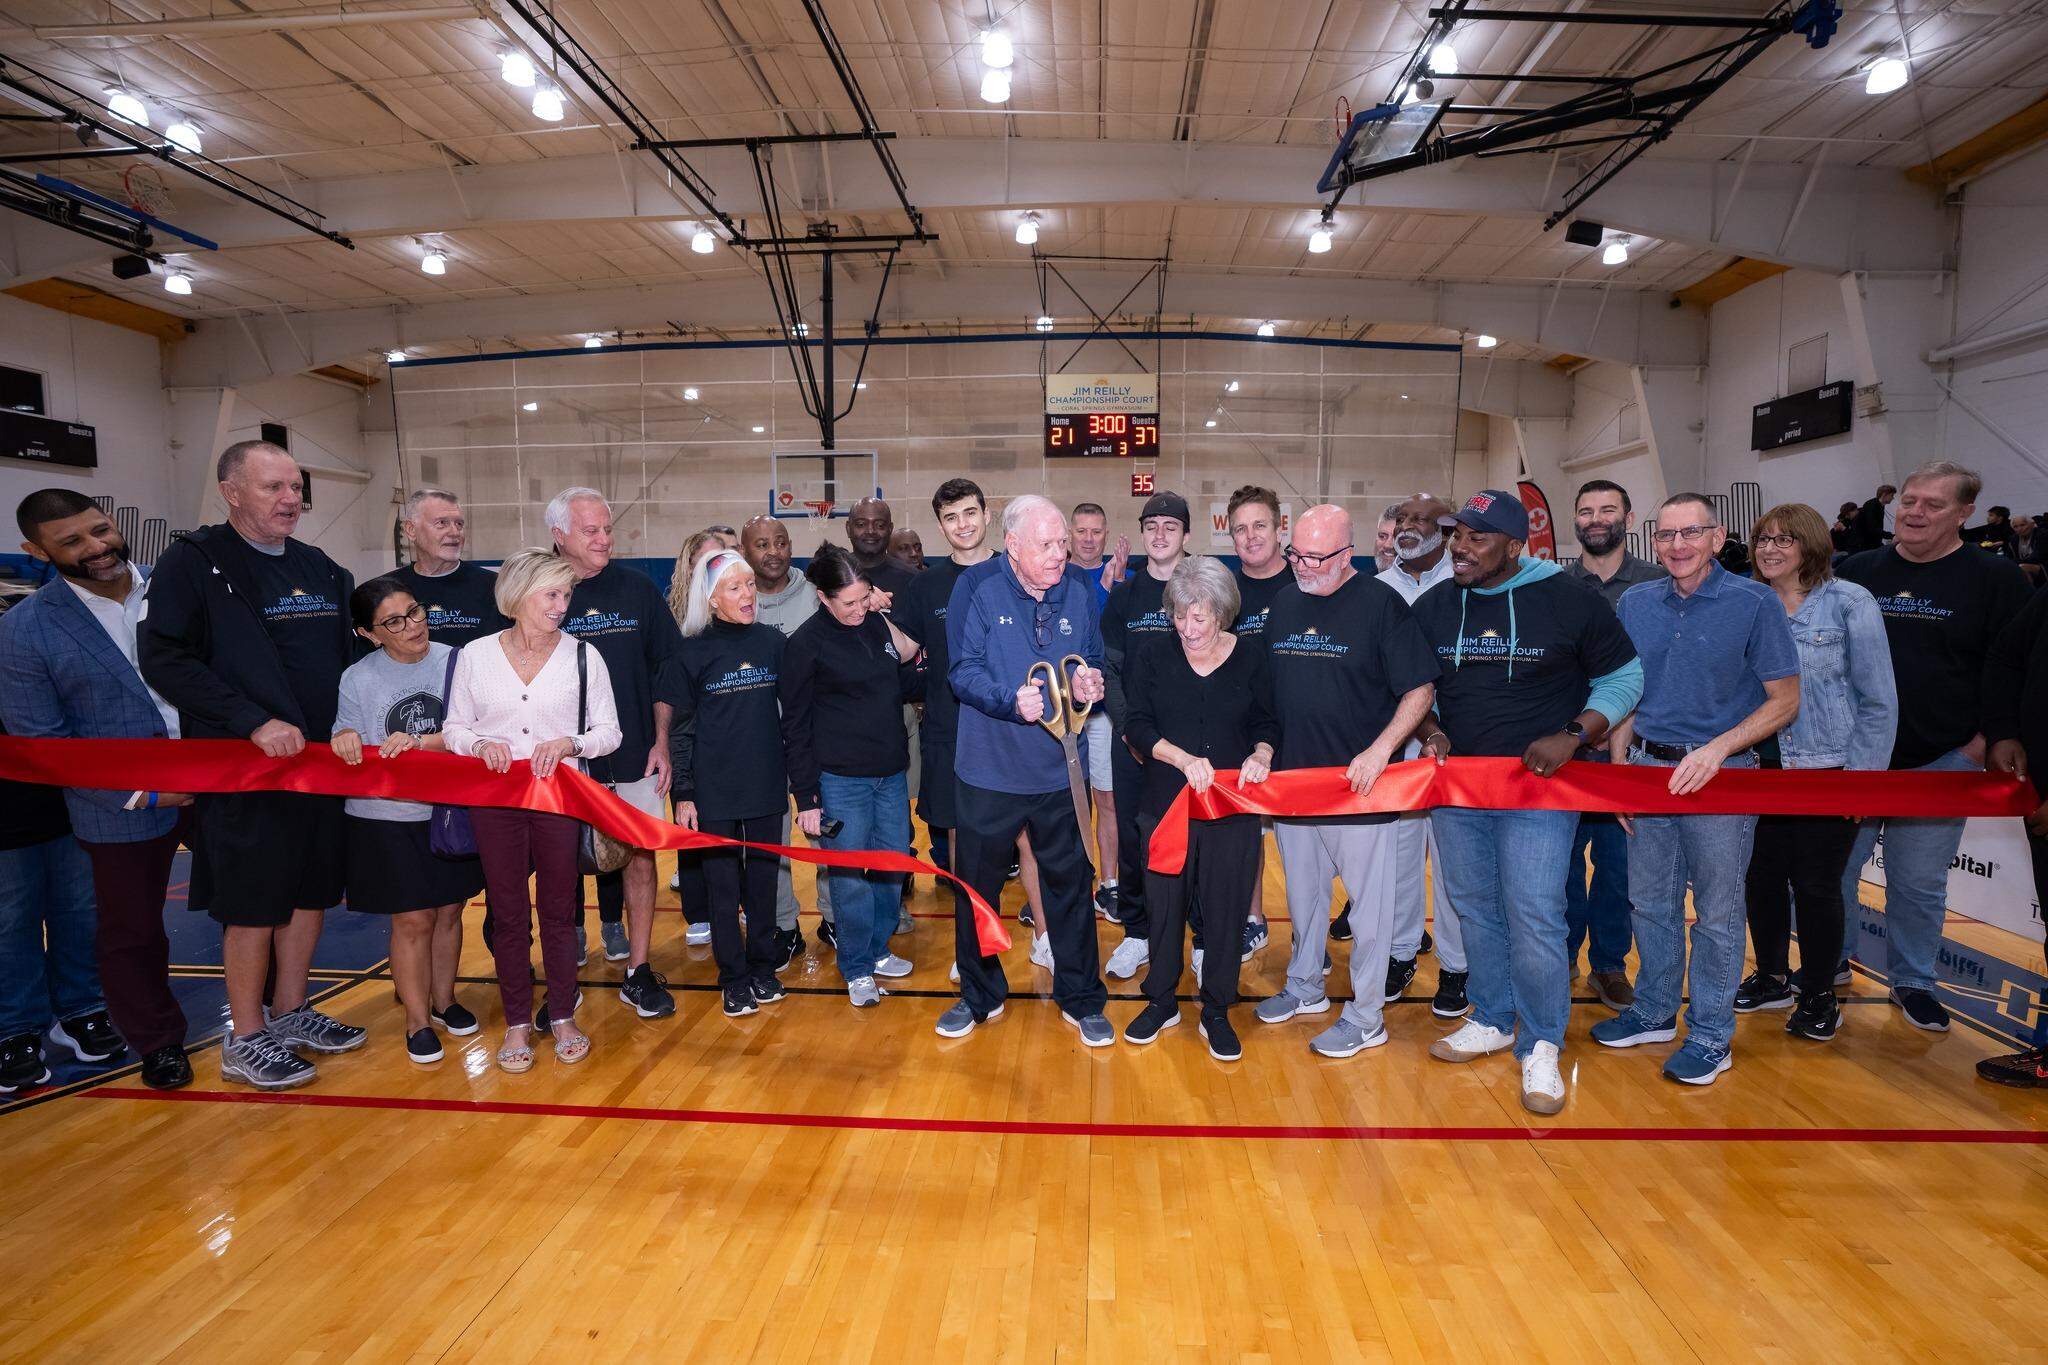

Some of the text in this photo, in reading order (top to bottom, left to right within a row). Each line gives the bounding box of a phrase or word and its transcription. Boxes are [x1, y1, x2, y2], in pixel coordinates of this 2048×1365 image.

[1073, 387, 1130, 396] JIM REILLY
[1050, 416, 1156, 433] Home 3:00 Guests
[1052, 426, 1156, 446] 21 37
[1092, 442, 1127, 455] period 3
[1134, 475, 1153, 491] 35
[279, 595, 325, 605] JIM REILLY
[1894, 598, 1932, 606] REILLY
[264, 605, 321, 614] HAMPIONSHIP
[429, 610, 461, 618] REILLY
[1919, 606, 1954, 616] COURT
[588, 612, 620, 624] REILLY
[562, 621, 611, 633] AMPIONSHIP
[1273, 642, 1348, 653] CHAMPIONSHIP COURT
[723, 667, 768, 680] JIM REILLY
[706, 676, 762, 690] CHAMPIONSHIP
[1949, 854, 2000, 879] pital®
